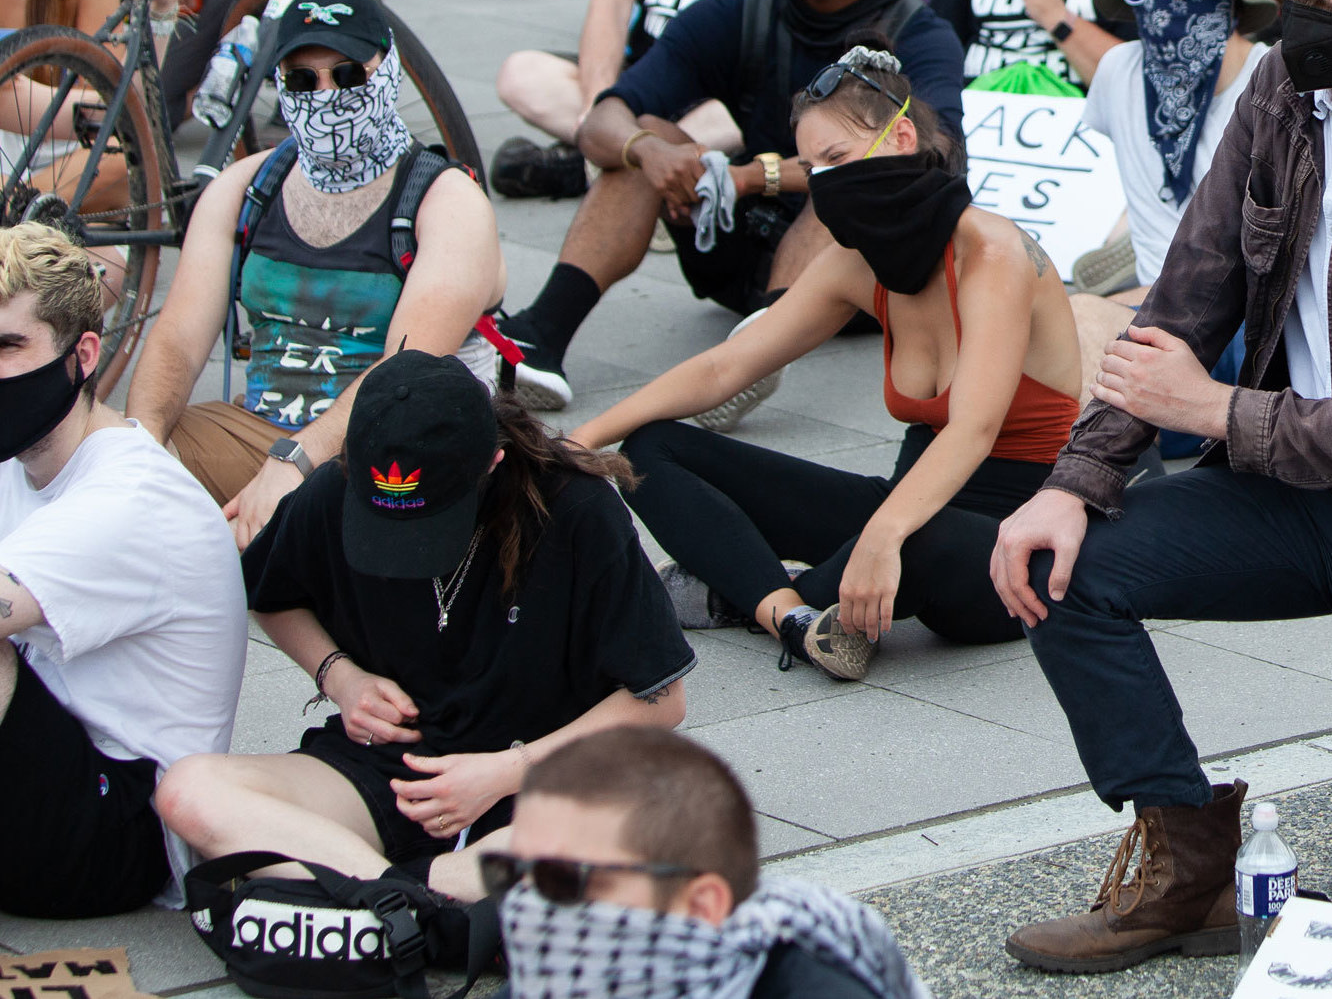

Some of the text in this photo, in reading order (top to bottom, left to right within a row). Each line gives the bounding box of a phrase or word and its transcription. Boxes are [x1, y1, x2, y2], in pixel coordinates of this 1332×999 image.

[371, 495, 425, 510] adidas
[1268, 875, 1296, 891] DEER
[1268, 888, 1297, 901] PARK
[236, 911, 390, 960] adida
